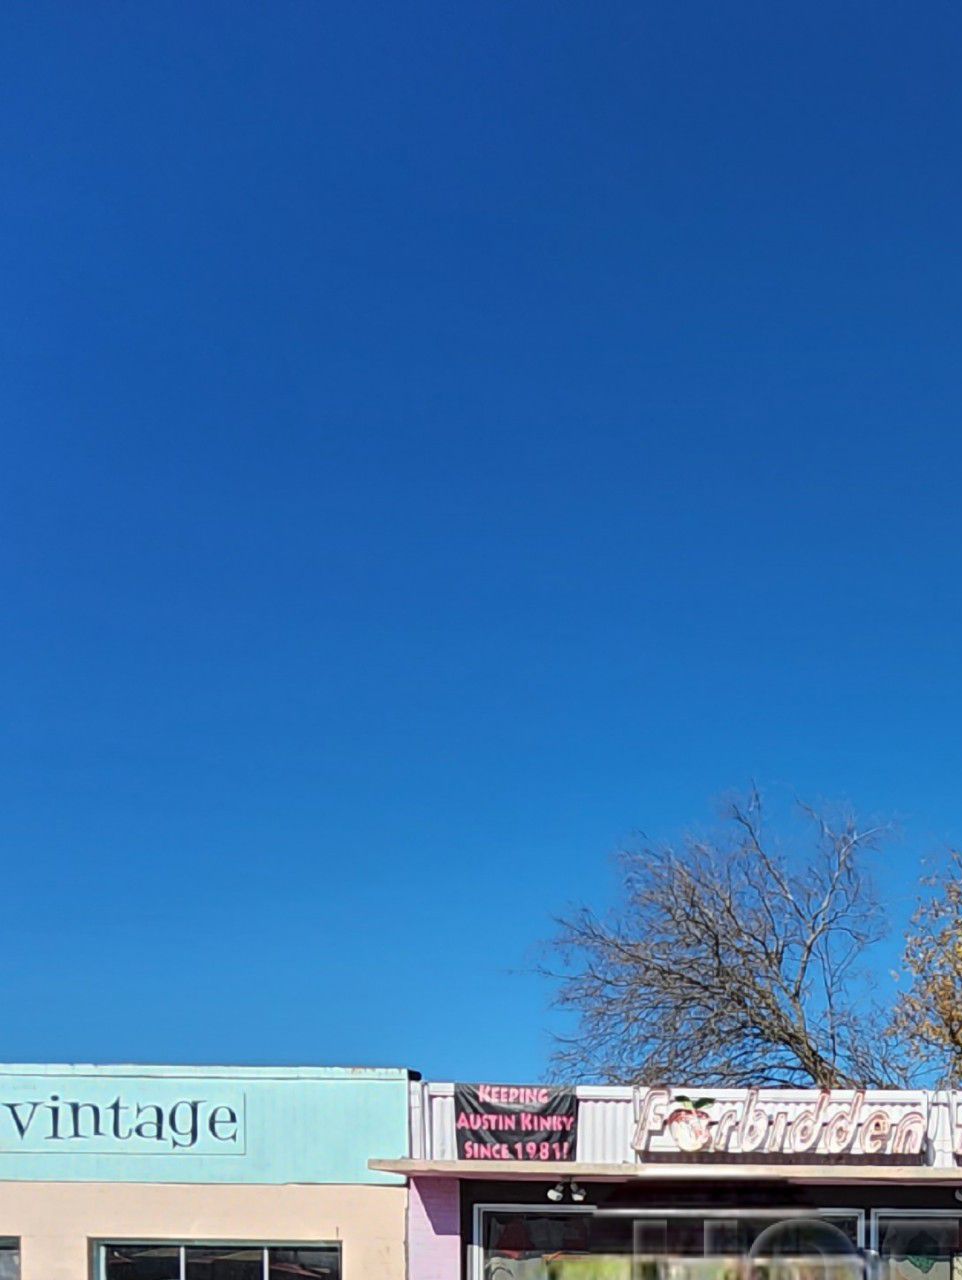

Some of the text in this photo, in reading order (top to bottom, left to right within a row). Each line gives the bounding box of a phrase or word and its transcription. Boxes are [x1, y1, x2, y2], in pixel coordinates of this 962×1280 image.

[478, 1085, 550, 1104] KEEPING
[1, 1095, 238, 1149] vintage
[456, 1112, 575, 1131] AUSTIN KINKY
[464, 1141, 571, 1160] SINCE 1981!
